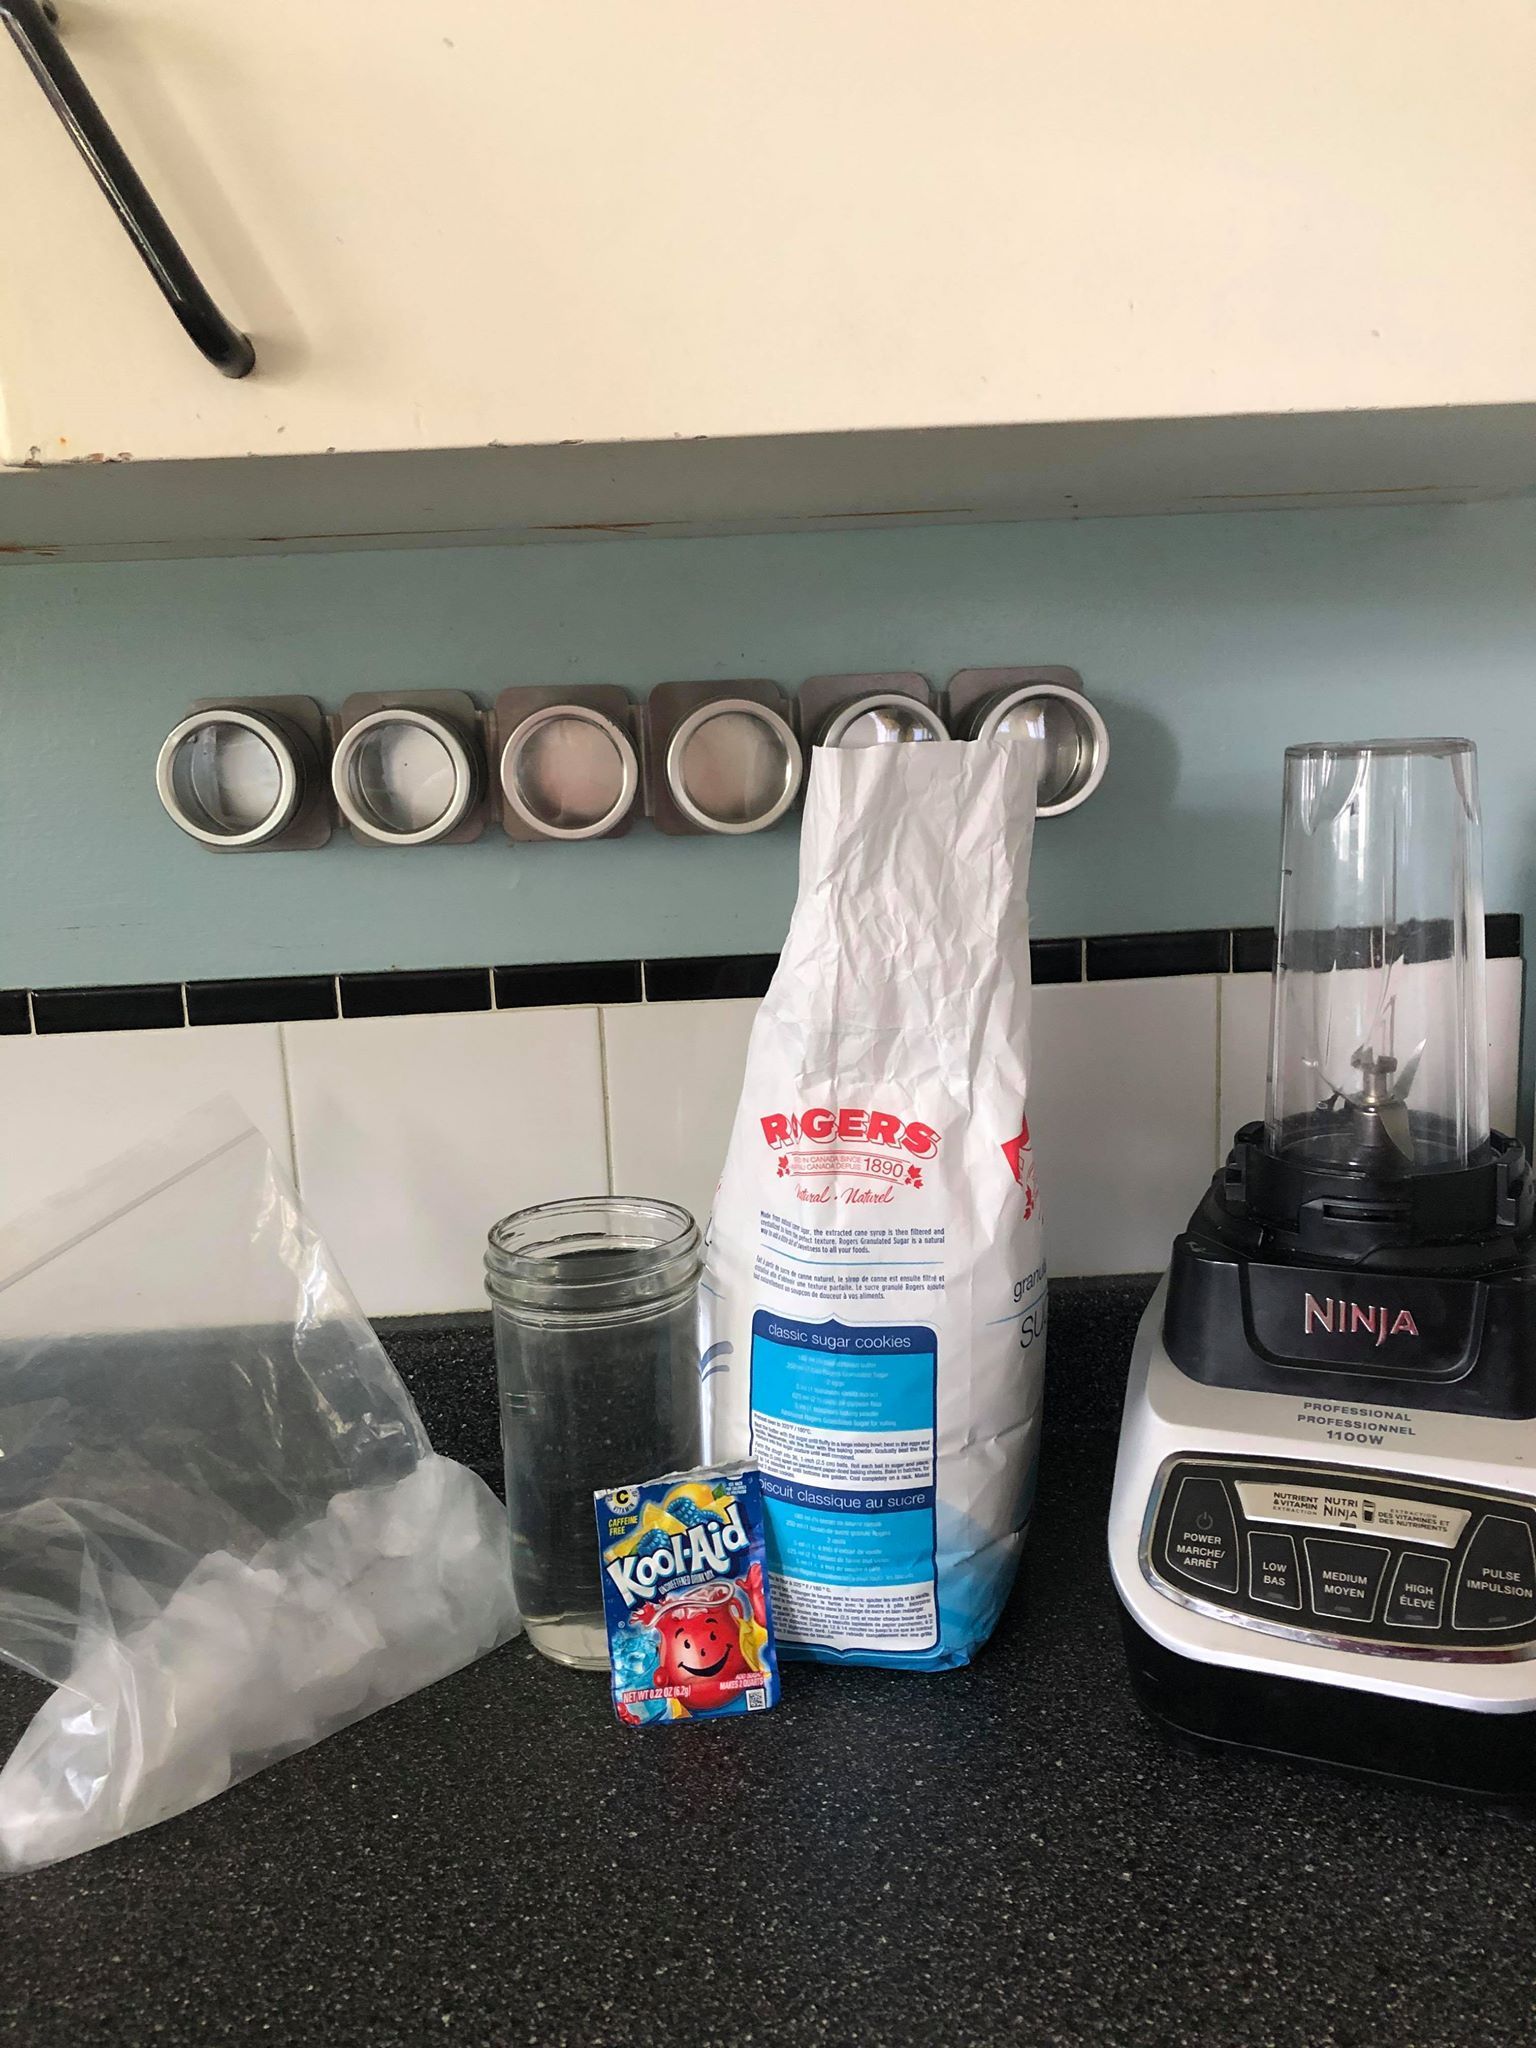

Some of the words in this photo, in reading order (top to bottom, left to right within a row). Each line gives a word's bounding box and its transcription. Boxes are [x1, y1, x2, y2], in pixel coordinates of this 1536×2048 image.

[810, 1155, 838, 1163] CANADA
[864, 1157, 904, 1178] 1890
[841, 1185, 895, 1204] Naturel
[825, 1229, 852, 1237] extracted
[854, 1229, 868, 1237] cane
[870, 1229, 886, 1238] syrup
[895, 1228, 909, 1236] then
[910, 1227, 932, 1236] filtered
[934, 1227, 945, 1235] and
[839, 1237, 858, 1246] Rogers
[860, 1237, 892, 1245] Granulated
[893, 1237, 910, 1246] Sugar
[924, 1236, 945, 1244] natural
[900, 1274, 920, 1282] ensuite
[905, 1283, 925, 1292] Rogers
[819, 1292, 842, 1300] douceur
[1304, 1292, 1419, 1347] NINJA
[768, 1323, 808, 1342] classic
[811, 1334, 850, 1350] sugar
[855, 1335, 911, 1349] cookies
[1303, 1402, 1412, 1422] PROFESSIONAL
[1297, 1414, 1416, 1436] PROFESSIONNEL
[1327, 1430, 1384, 1445] 1100W
[617, 1490, 629, 1504] C
[797, 1490, 861, 1511] classique
[865, 1498, 883, 1509] au
[887, 1493, 925, 1507] sucre
[1273, 1492, 1318, 1503] NUTRIENT
[1324, 1496, 1358, 1508] NUTRI
[1323, 1505, 1358, 1521] NINJA
[1378, 1511, 1393, 1519] DES
[1395, 1514, 1437, 1525] VITAMINES
[608, 1515, 638, 1528] CAFFEINE
[1396, 1520, 1448, 1532] NUTRIMENTS
[609, 1526, 626, 1537] FREE
[1183, 1532, 1222, 1545] POWER
[606, 1501, 750, 1609] Kool-Aid
[1176, 1544, 1226, 1559] MARCHE/
[1183, 1556, 1219, 1569] ARRÊT
[1262, 1562, 1287, 1573] LOW
[1263, 1575, 1286, 1586] BAS
[1322, 1570, 1368, 1585] MEDIUM
[1482, 1567, 1521, 1582] PULSE
[1324, 1585, 1365, 1599] MOYEN
[1404, 1583, 1434, 1596] HIGH
[1466, 1580, 1534, 1599] IMPULSION
[1399, 1594, 1436, 1610] ÉLEVÉ
[719, 1680, 739, 1690] MAKES
[738, 1679, 744, 1688] 2
[623, 1691, 637, 1704] NET
[637, 1689, 649, 1701] WT
[649, 1687, 663, 1700] 0.22
[663, 1686, 674, 1698] OZ
